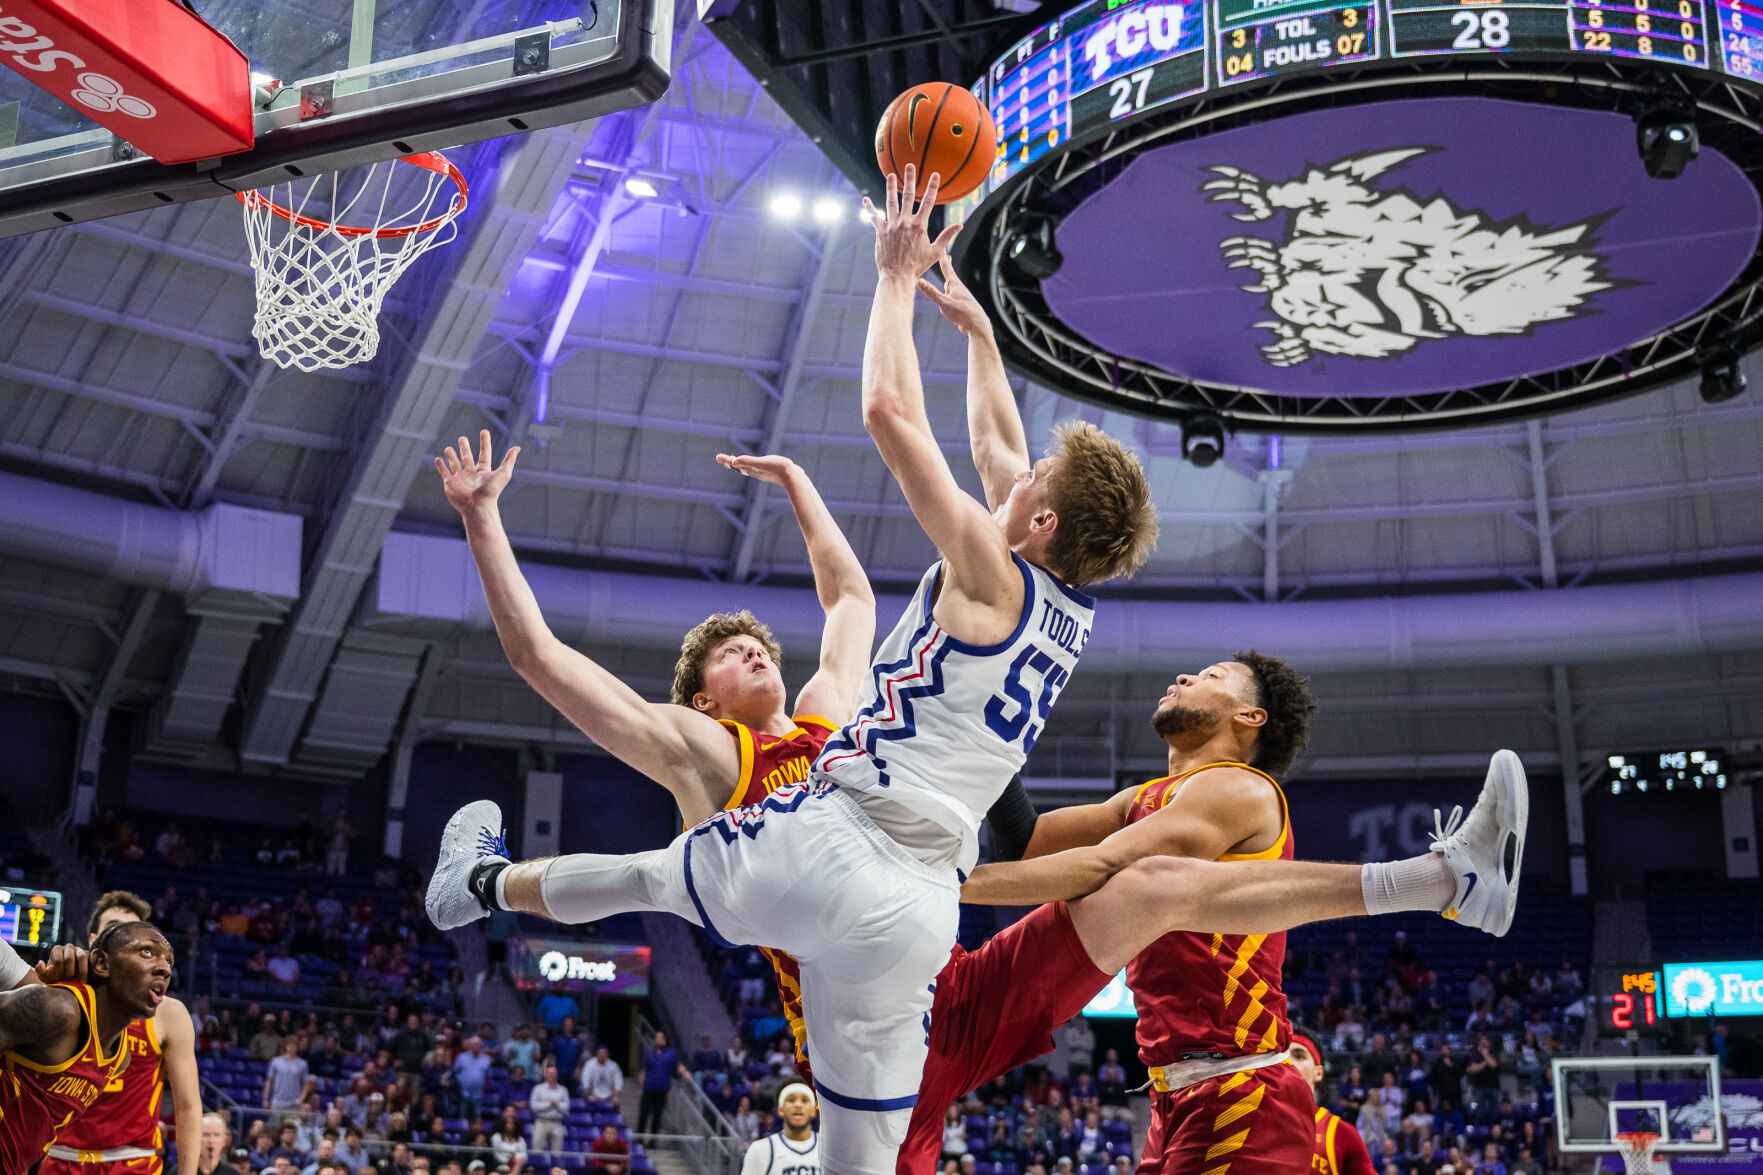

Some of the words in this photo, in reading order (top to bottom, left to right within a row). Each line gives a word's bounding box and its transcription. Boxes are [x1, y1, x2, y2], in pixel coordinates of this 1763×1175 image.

[1588, 9, 1603, 28] 5
[1636, 14, 1650, 32] 5
[1681, 21, 1694, 40] 0
[1679, 0, 1692, 18] 0
[0, 6, 86, 72] Sta
[1085, 4, 1184, 81] TCU
[1232, 29, 1246, 48] 3
[1276, 19, 1316, 40] TOL
[1343, 8, 1357, 28] 3
[1451, 9, 1510, 49] 28
[1729, 32, 1749, 54] 24
[1226, 52, 1254, 76] 04
[1263, 39, 1331, 68] FOULS
[1337, 32, 1365, 55] 07
[1584, 31, 1611, 51] 22
[1638, 36, 1652, 54] 8
[1683, 43, 1696, 62] 0
[1048, 69, 1058, 86] 0
[1731, 54, 1752, 75] 55
[1048, 89, 1058, 106] 0
[1109, 67, 1154, 118] 27
[1048, 128, 1058, 147] 0
[762, 755, 811, 795] IOWA
[1349, 803, 1445, 862] TC
[1612, 993, 1655, 1028] 21
[47, 1076, 88, 1098] IOWA
